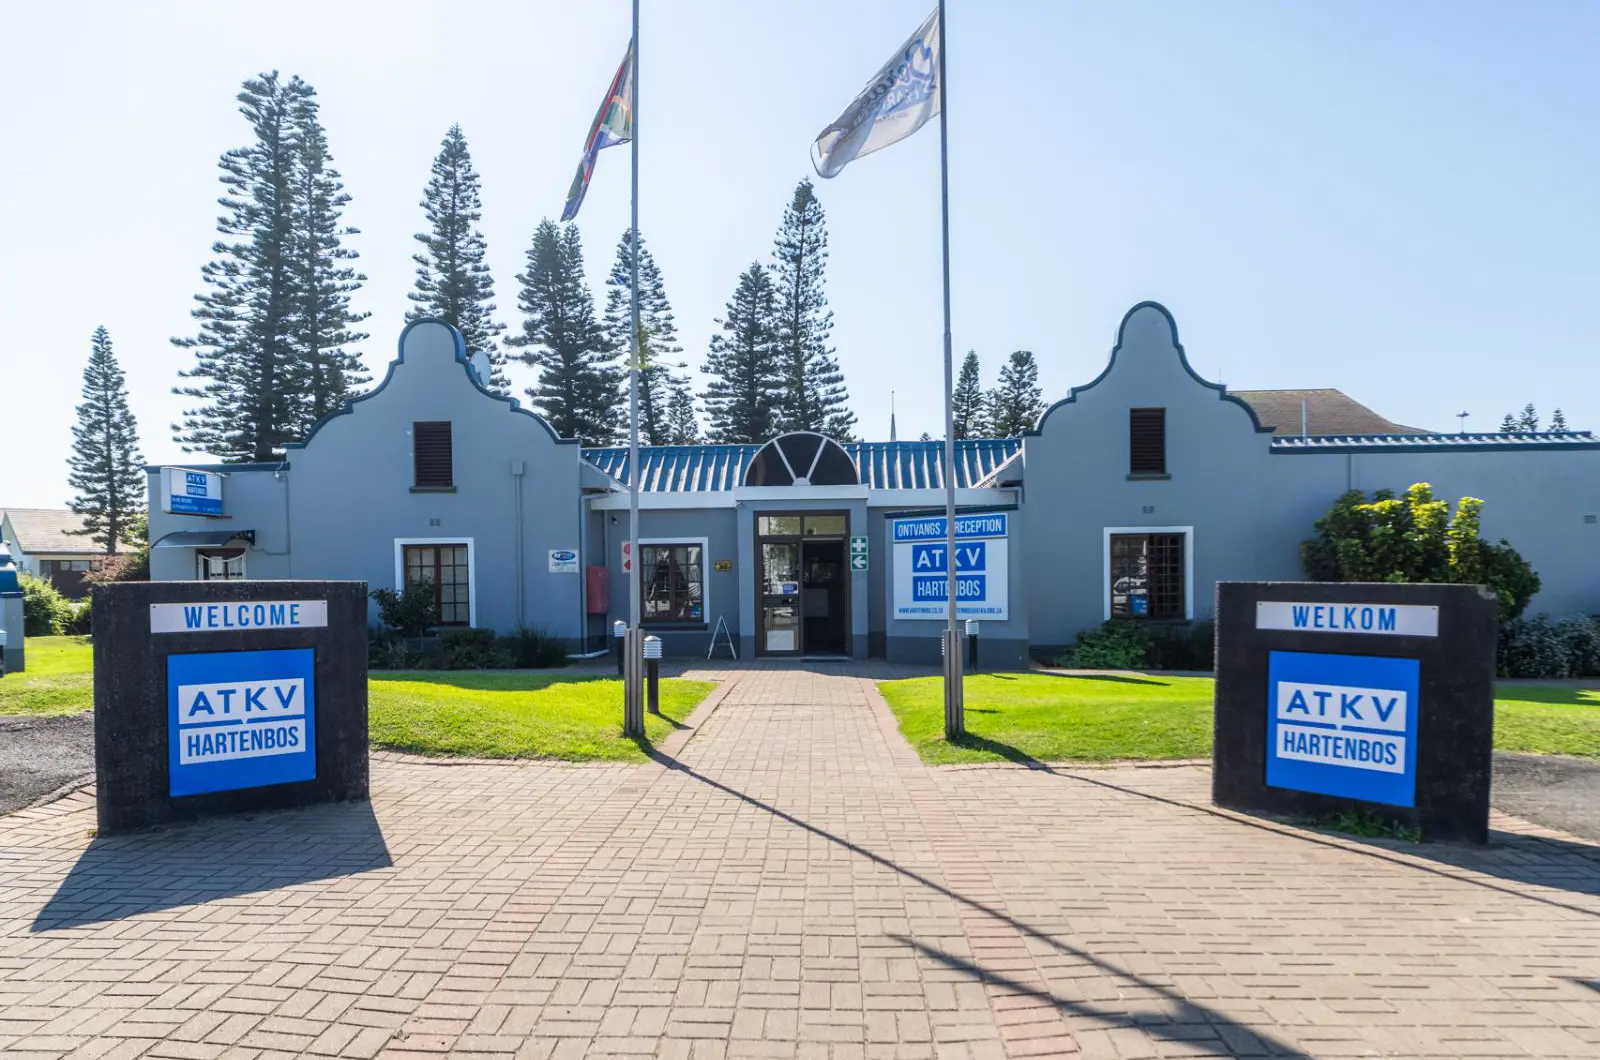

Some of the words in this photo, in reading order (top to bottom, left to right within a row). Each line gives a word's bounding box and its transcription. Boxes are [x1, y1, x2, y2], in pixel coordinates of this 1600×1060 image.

[187, 474, 206, 483] ATKV
[897, 522, 941, 537] ONTVANGS
[954, 518, 1002, 534] RECEPTION
[917, 579, 981, 597] HARTEBOS
[184, 603, 300, 628] WELCOME
[1292, 605, 1396, 631] WELKOM
[188, 684, 297, 717] ATKV
[1285, 689, 1399, 722] ATKV
[187, 725, 299, 757] HARTENBOS
[1283, 730, 1397, 766] HARTENBOS
